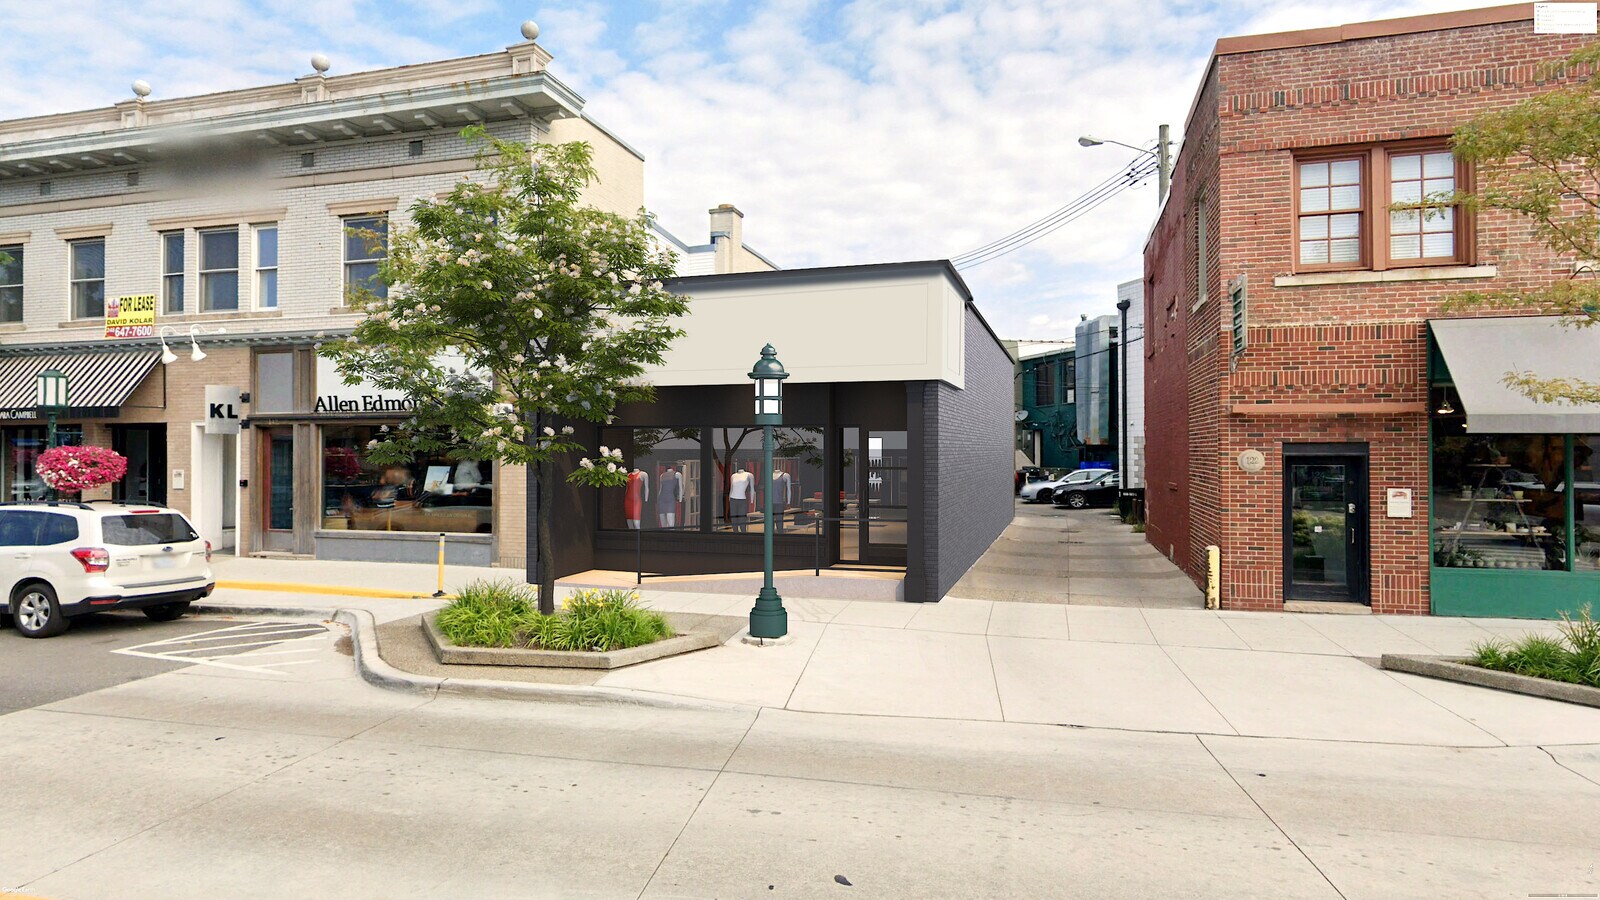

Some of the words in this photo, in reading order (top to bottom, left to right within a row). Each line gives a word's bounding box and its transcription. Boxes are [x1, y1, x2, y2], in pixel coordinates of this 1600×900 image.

[119, 297, 133, 312] FOR
[133, 295, 154, 311] LEASE
[115, 325, 152, 337] 647-7600
[210, 403, 238, 418] KL
[314, 396, 359, 412] Allen
